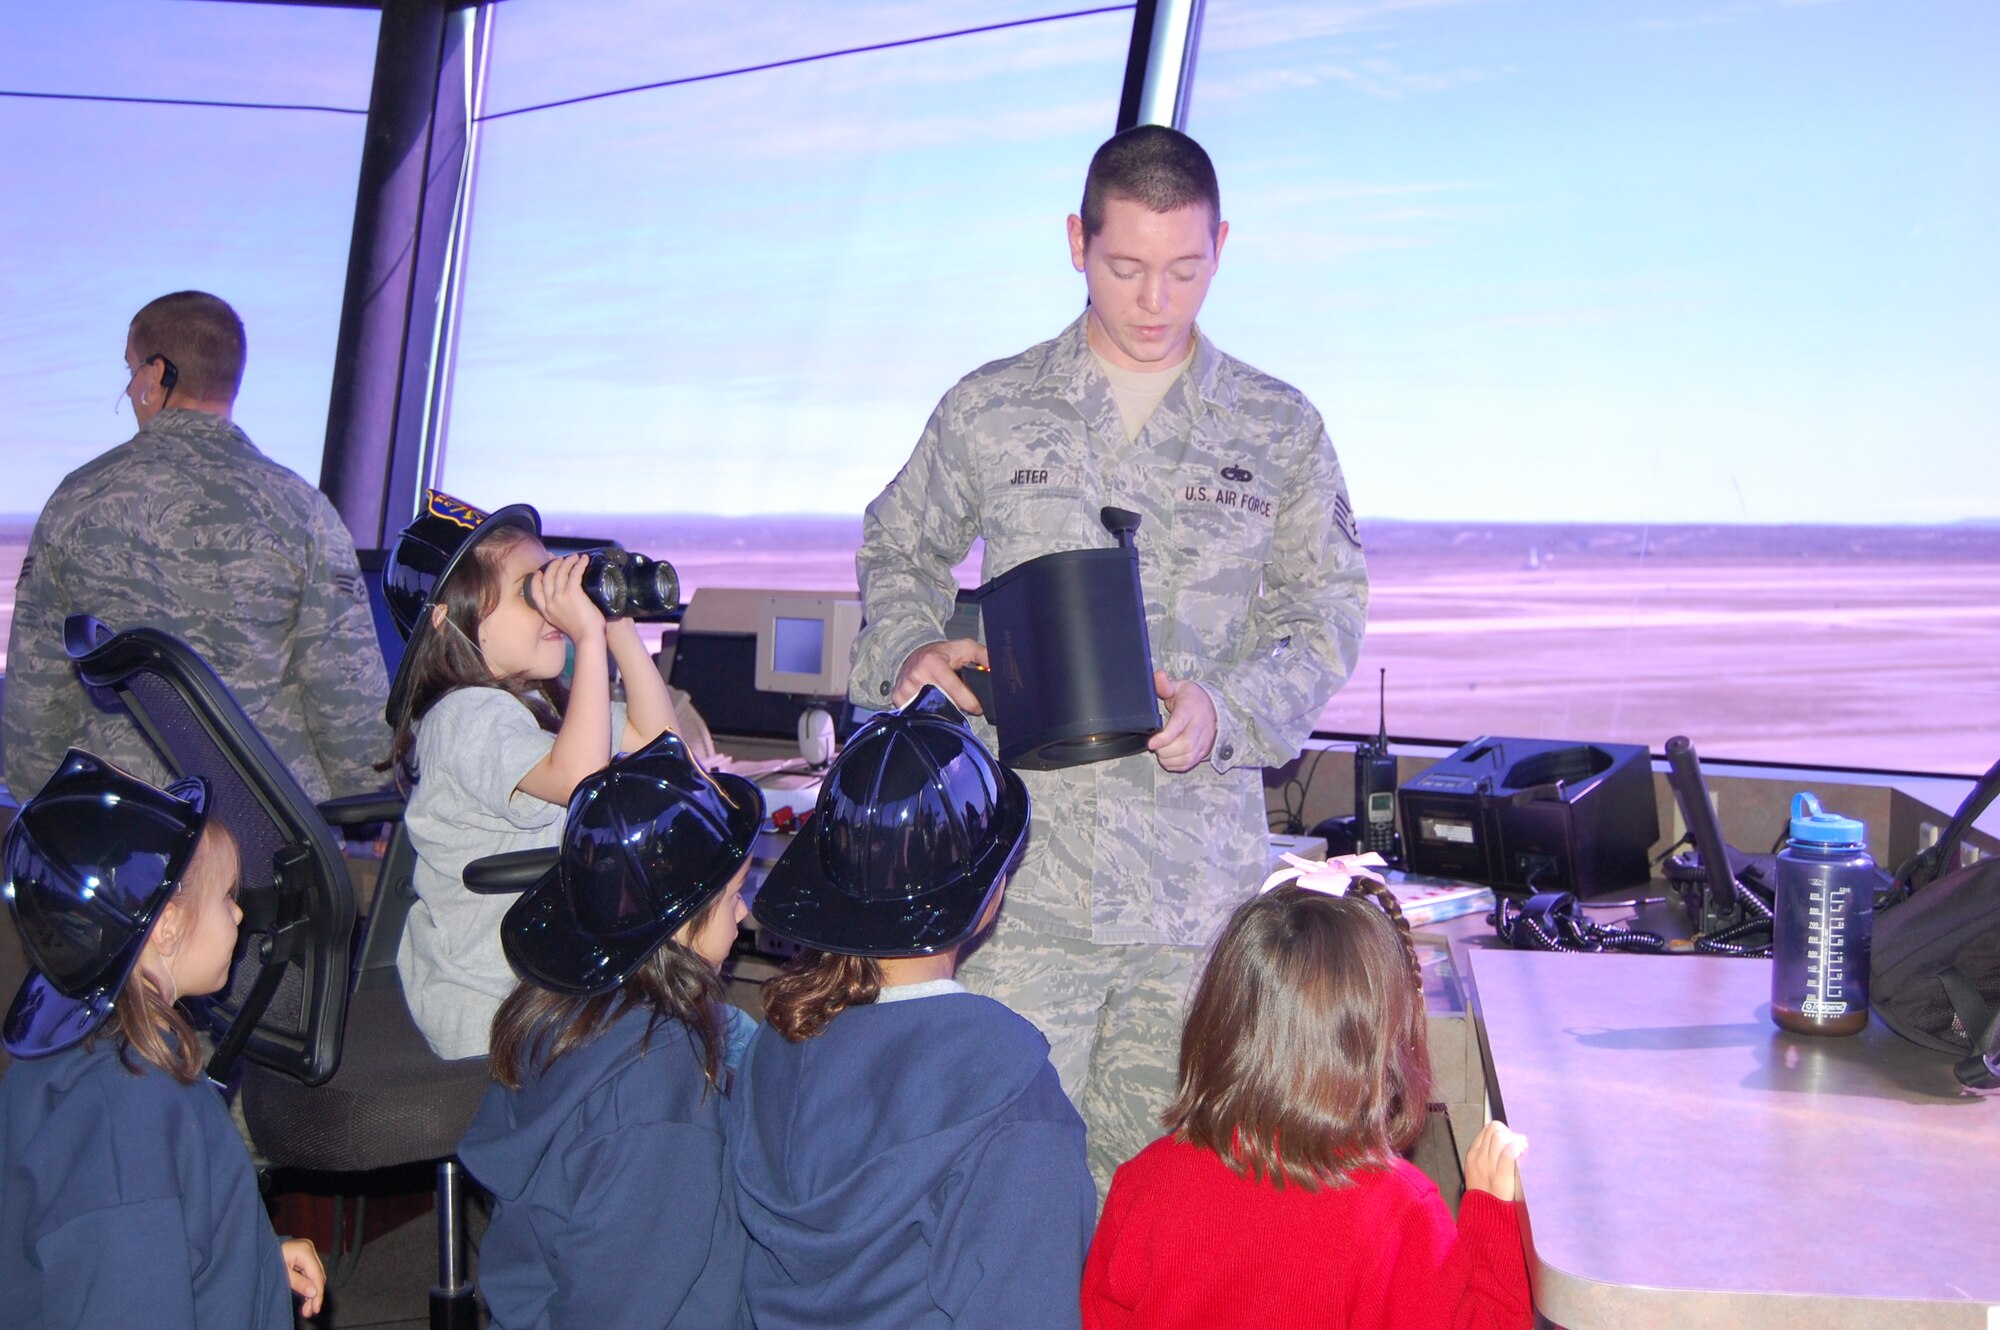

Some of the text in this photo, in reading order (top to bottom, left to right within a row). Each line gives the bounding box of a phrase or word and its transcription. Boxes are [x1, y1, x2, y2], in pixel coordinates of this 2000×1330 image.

[1010, 469, 1049, 485] JETER
[1184, 486, 1272, 518] U.S. AIR FORCE
